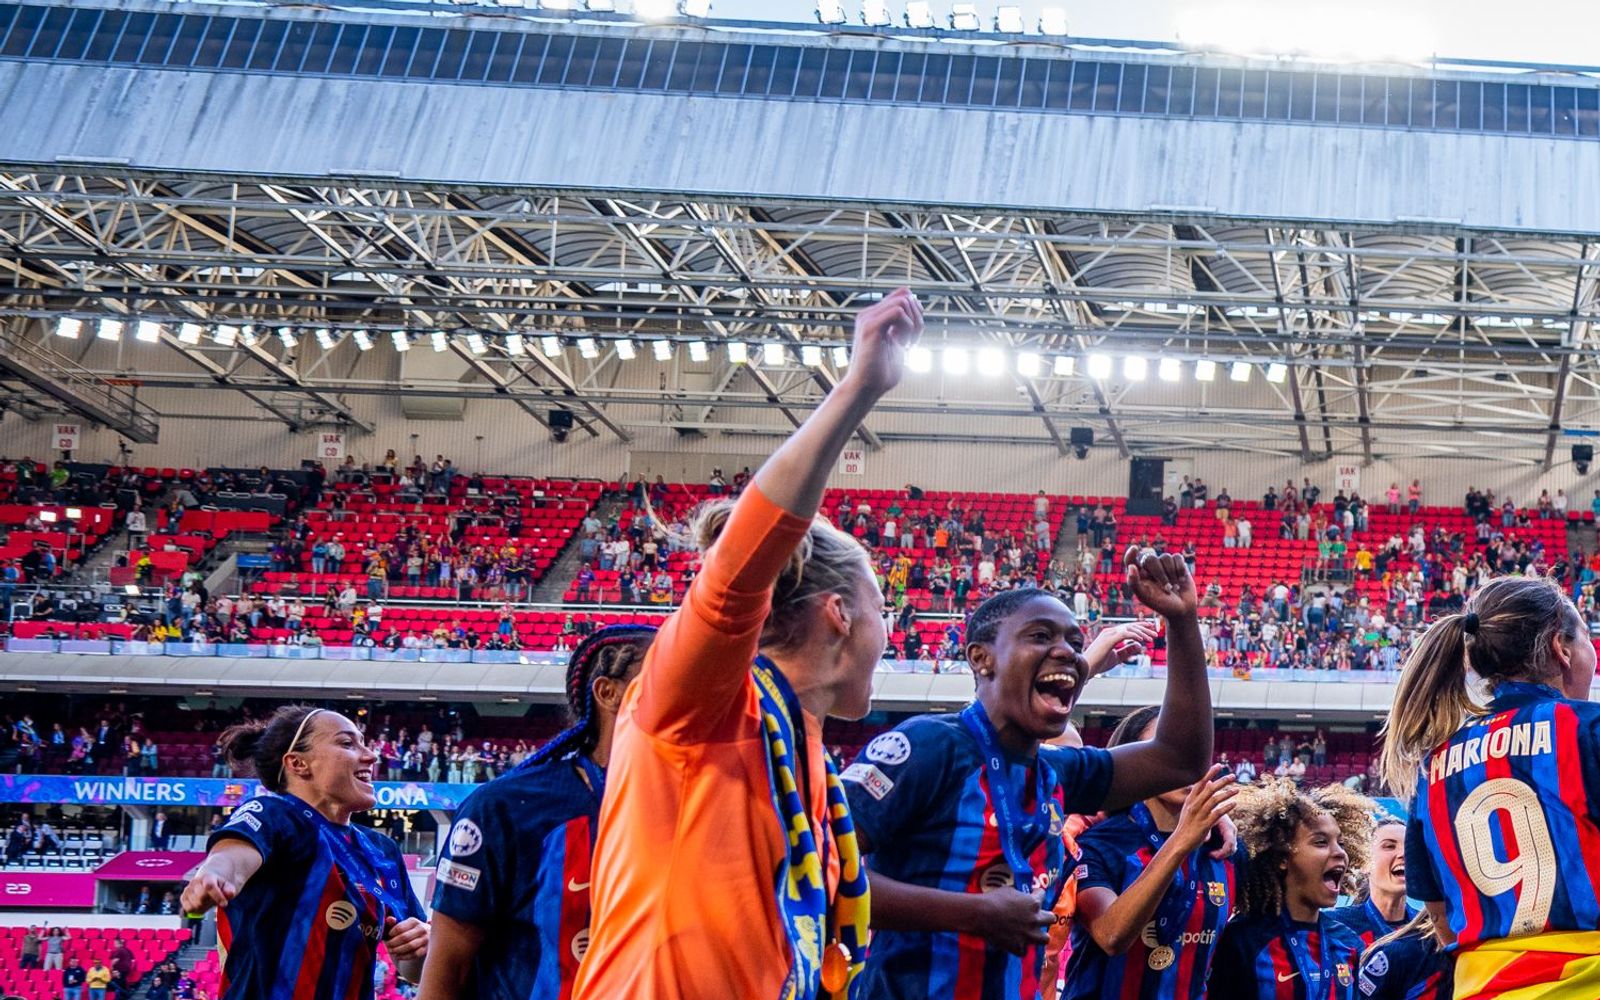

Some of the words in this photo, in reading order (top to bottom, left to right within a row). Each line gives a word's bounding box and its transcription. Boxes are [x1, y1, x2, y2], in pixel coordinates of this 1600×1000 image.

[57, 426, 77, 435] VAK
[322, 434, 341, 444] VAK
[844, 451, 861, 460] VAK
[1340, 467, 1356, 476] VAK
[1429, 720, 1553, 787] MARIONA
[75, 782, 187, 802] WINNERS
[1455, 777, 1557, 938] 9
